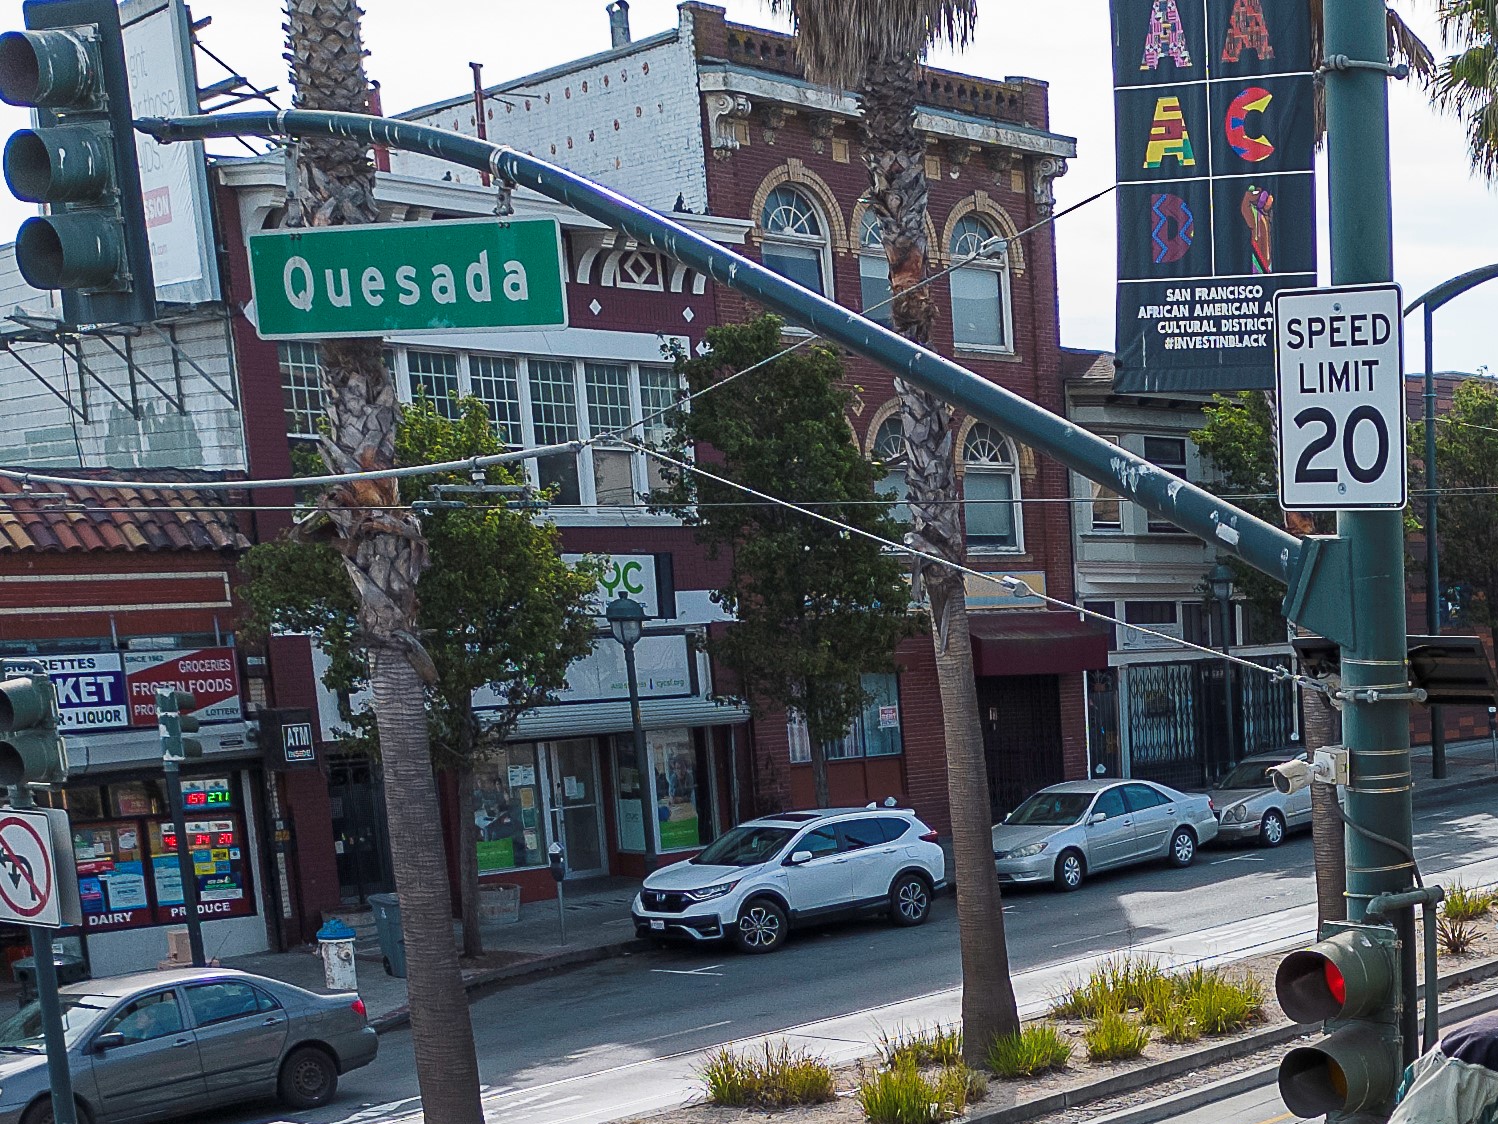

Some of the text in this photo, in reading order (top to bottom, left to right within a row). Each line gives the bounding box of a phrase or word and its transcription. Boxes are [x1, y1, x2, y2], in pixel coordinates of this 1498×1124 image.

[1139, 0, 1275, 71] A A
[1143, 87, 1275, 169] A C
[1151, 193, 1194, 264] D
[283, 249, 529, 312] Quesada
[1166, 285, 1263, 301] SAN FRANCISCO
[1138, 305, 1190, 319] AFRICAN
[1194, 302, 1259, 318] AMERICAN
[1158, 318, 1274, 334] CULTURAL DISTRICT
[1286, 313, 1391, 350] SPEED
[1164, 334, 1268, 350] #INVESTINBLACK
[1299, 359, 1380, 394] LIMIT
[1293, 405, 1390, 484] 20
[178, 659, 231, 673] GROCERIES
[189, 678, 233, 693] FOODS
[76, 710, 122, 725] LIQUOR
[205, 707, 239, 717] LOTTERY
[287, 726, 310, 747] ATM
[171, 902, 231, 918] PRDUCE
[89, 912, 133, 926] DAIRY
